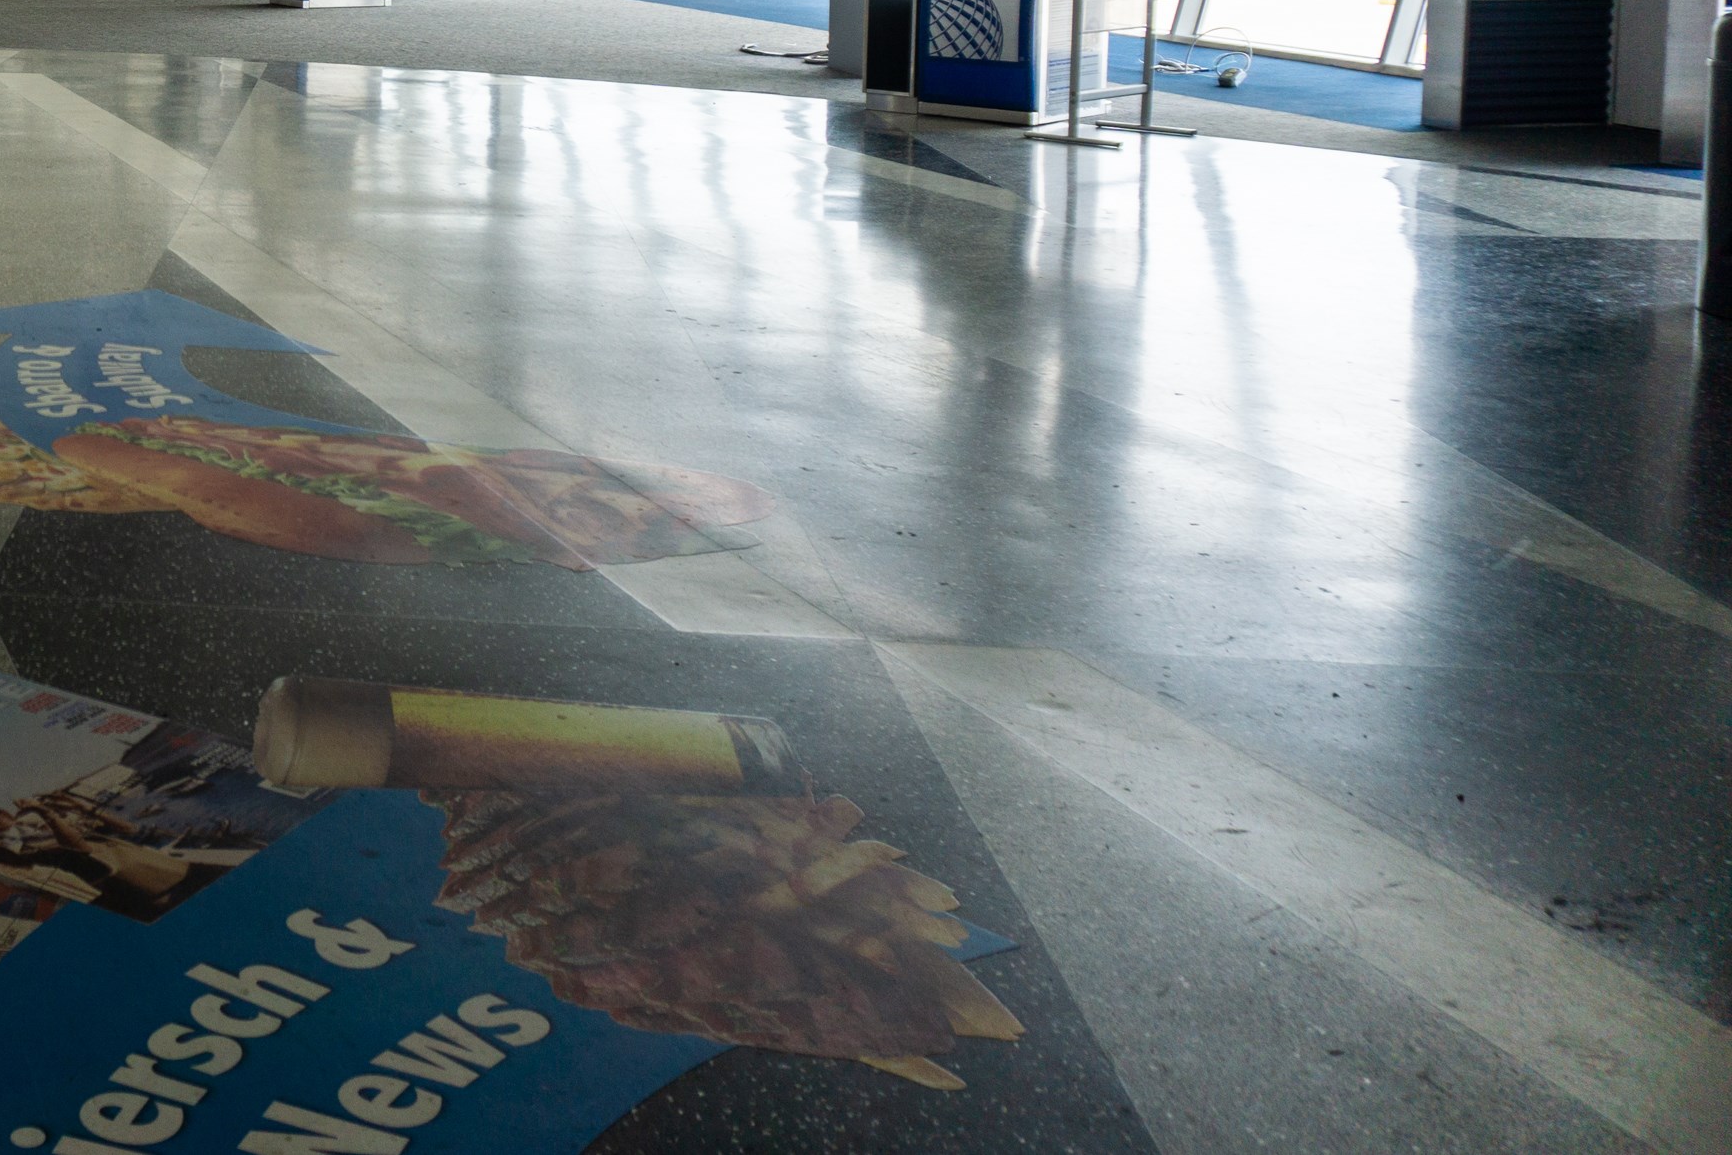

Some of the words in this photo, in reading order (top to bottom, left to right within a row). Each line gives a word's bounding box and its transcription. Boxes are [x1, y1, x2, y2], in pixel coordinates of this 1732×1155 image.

[93, 342, 194, 409] Subway
[286, 908, 417, 970] &
[237, 993, 552, 1155] News
